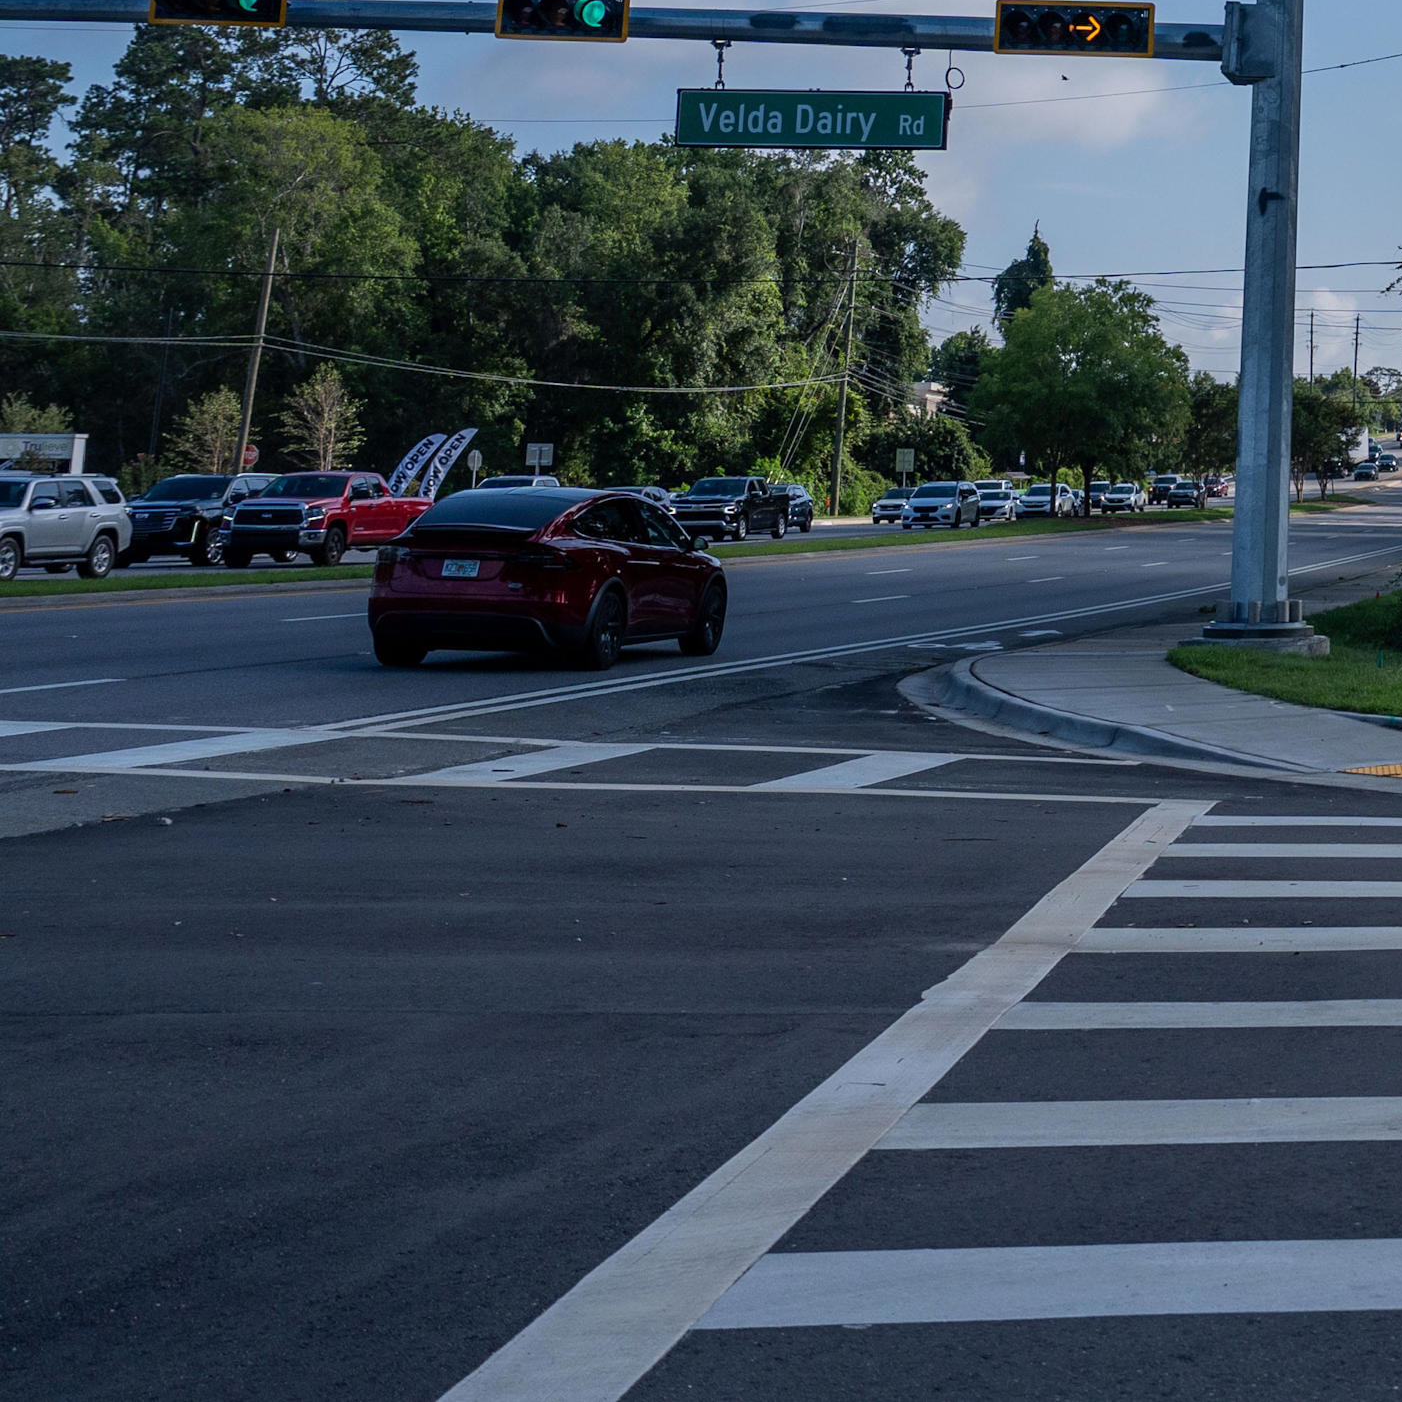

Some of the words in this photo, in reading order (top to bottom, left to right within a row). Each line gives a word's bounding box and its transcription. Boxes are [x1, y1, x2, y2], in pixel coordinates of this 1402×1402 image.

[699, 103, 783, 134] Velda
[795, 104, 877, 142] Dairy
[899, 115, 924, 135] Rd
[405, 438, 435, 471] OPEN
[438, 433, 467, 465] OPEN
